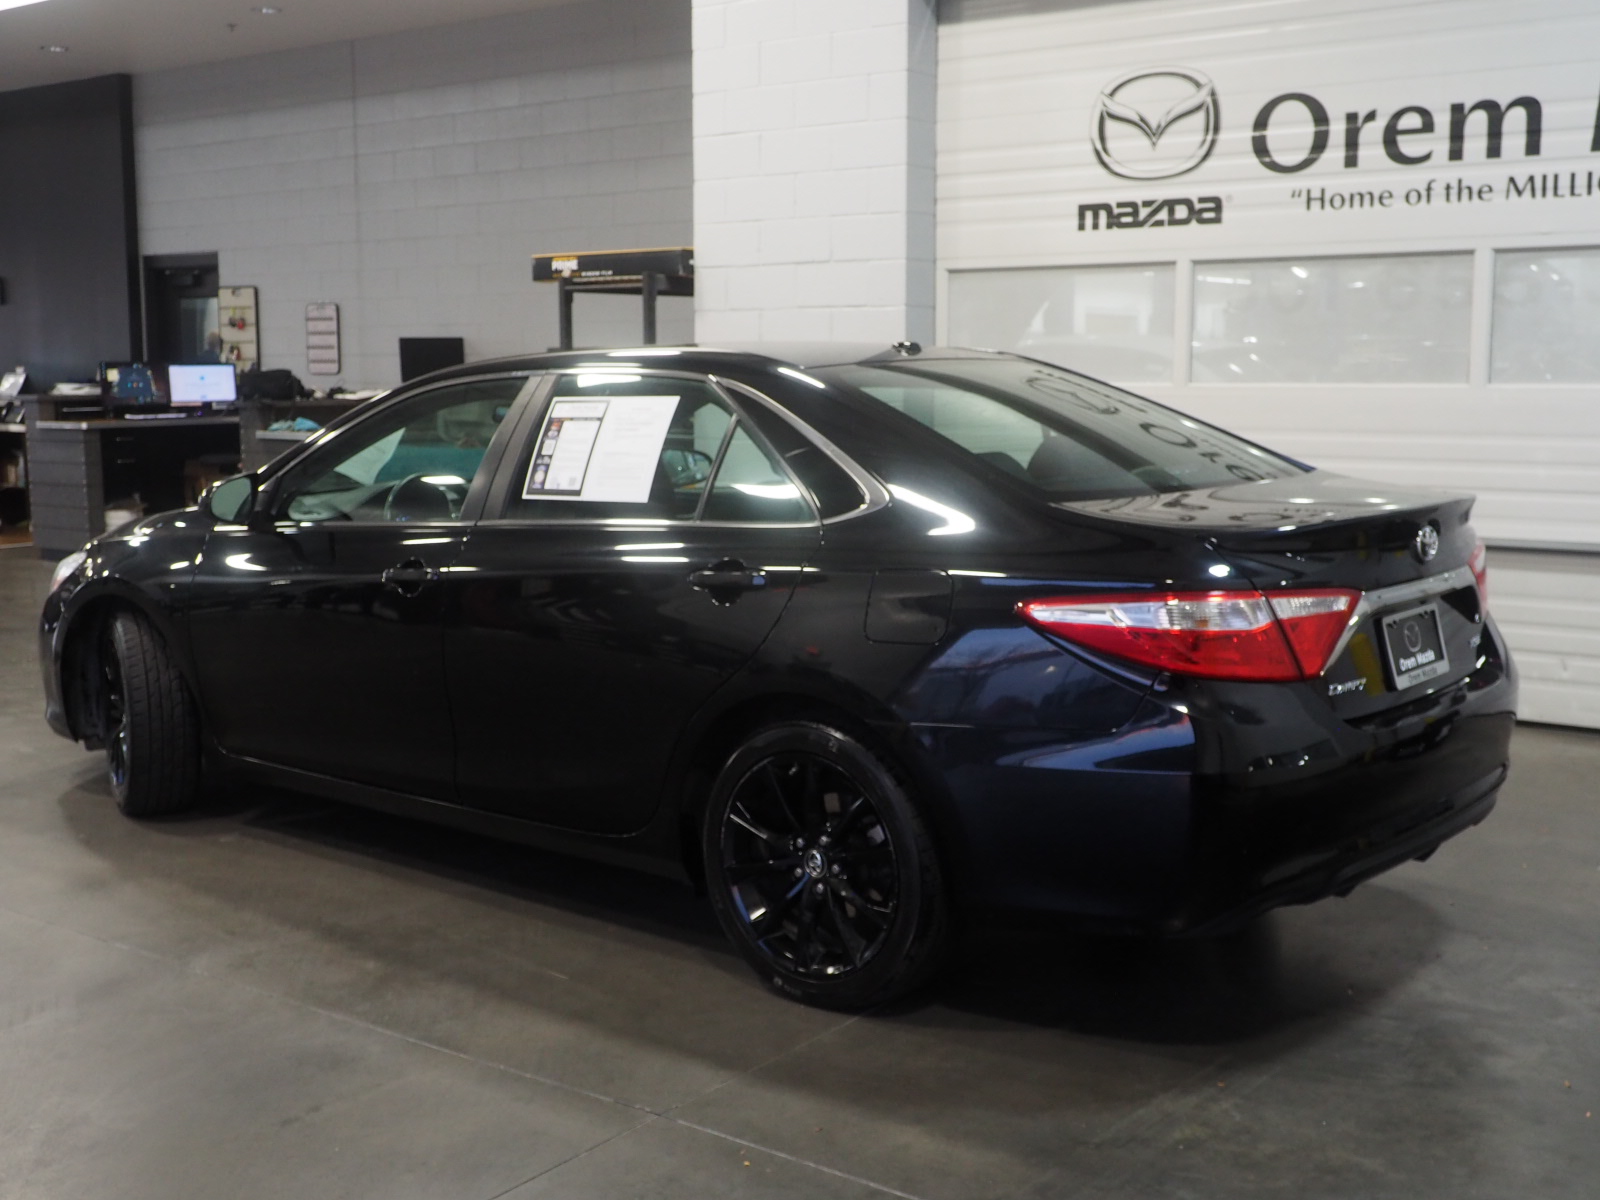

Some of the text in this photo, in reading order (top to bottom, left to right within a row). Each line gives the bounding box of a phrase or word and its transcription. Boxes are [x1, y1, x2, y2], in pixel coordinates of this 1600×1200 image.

[1251, 91, 1542, 174] Orem
[1404, 180, 1439, 206] of
[1444, 178, 1494, 204] the
[1505, 171, 1600, 201] MILLI
[1400, 649, 1435, 671] Orem Mazda
